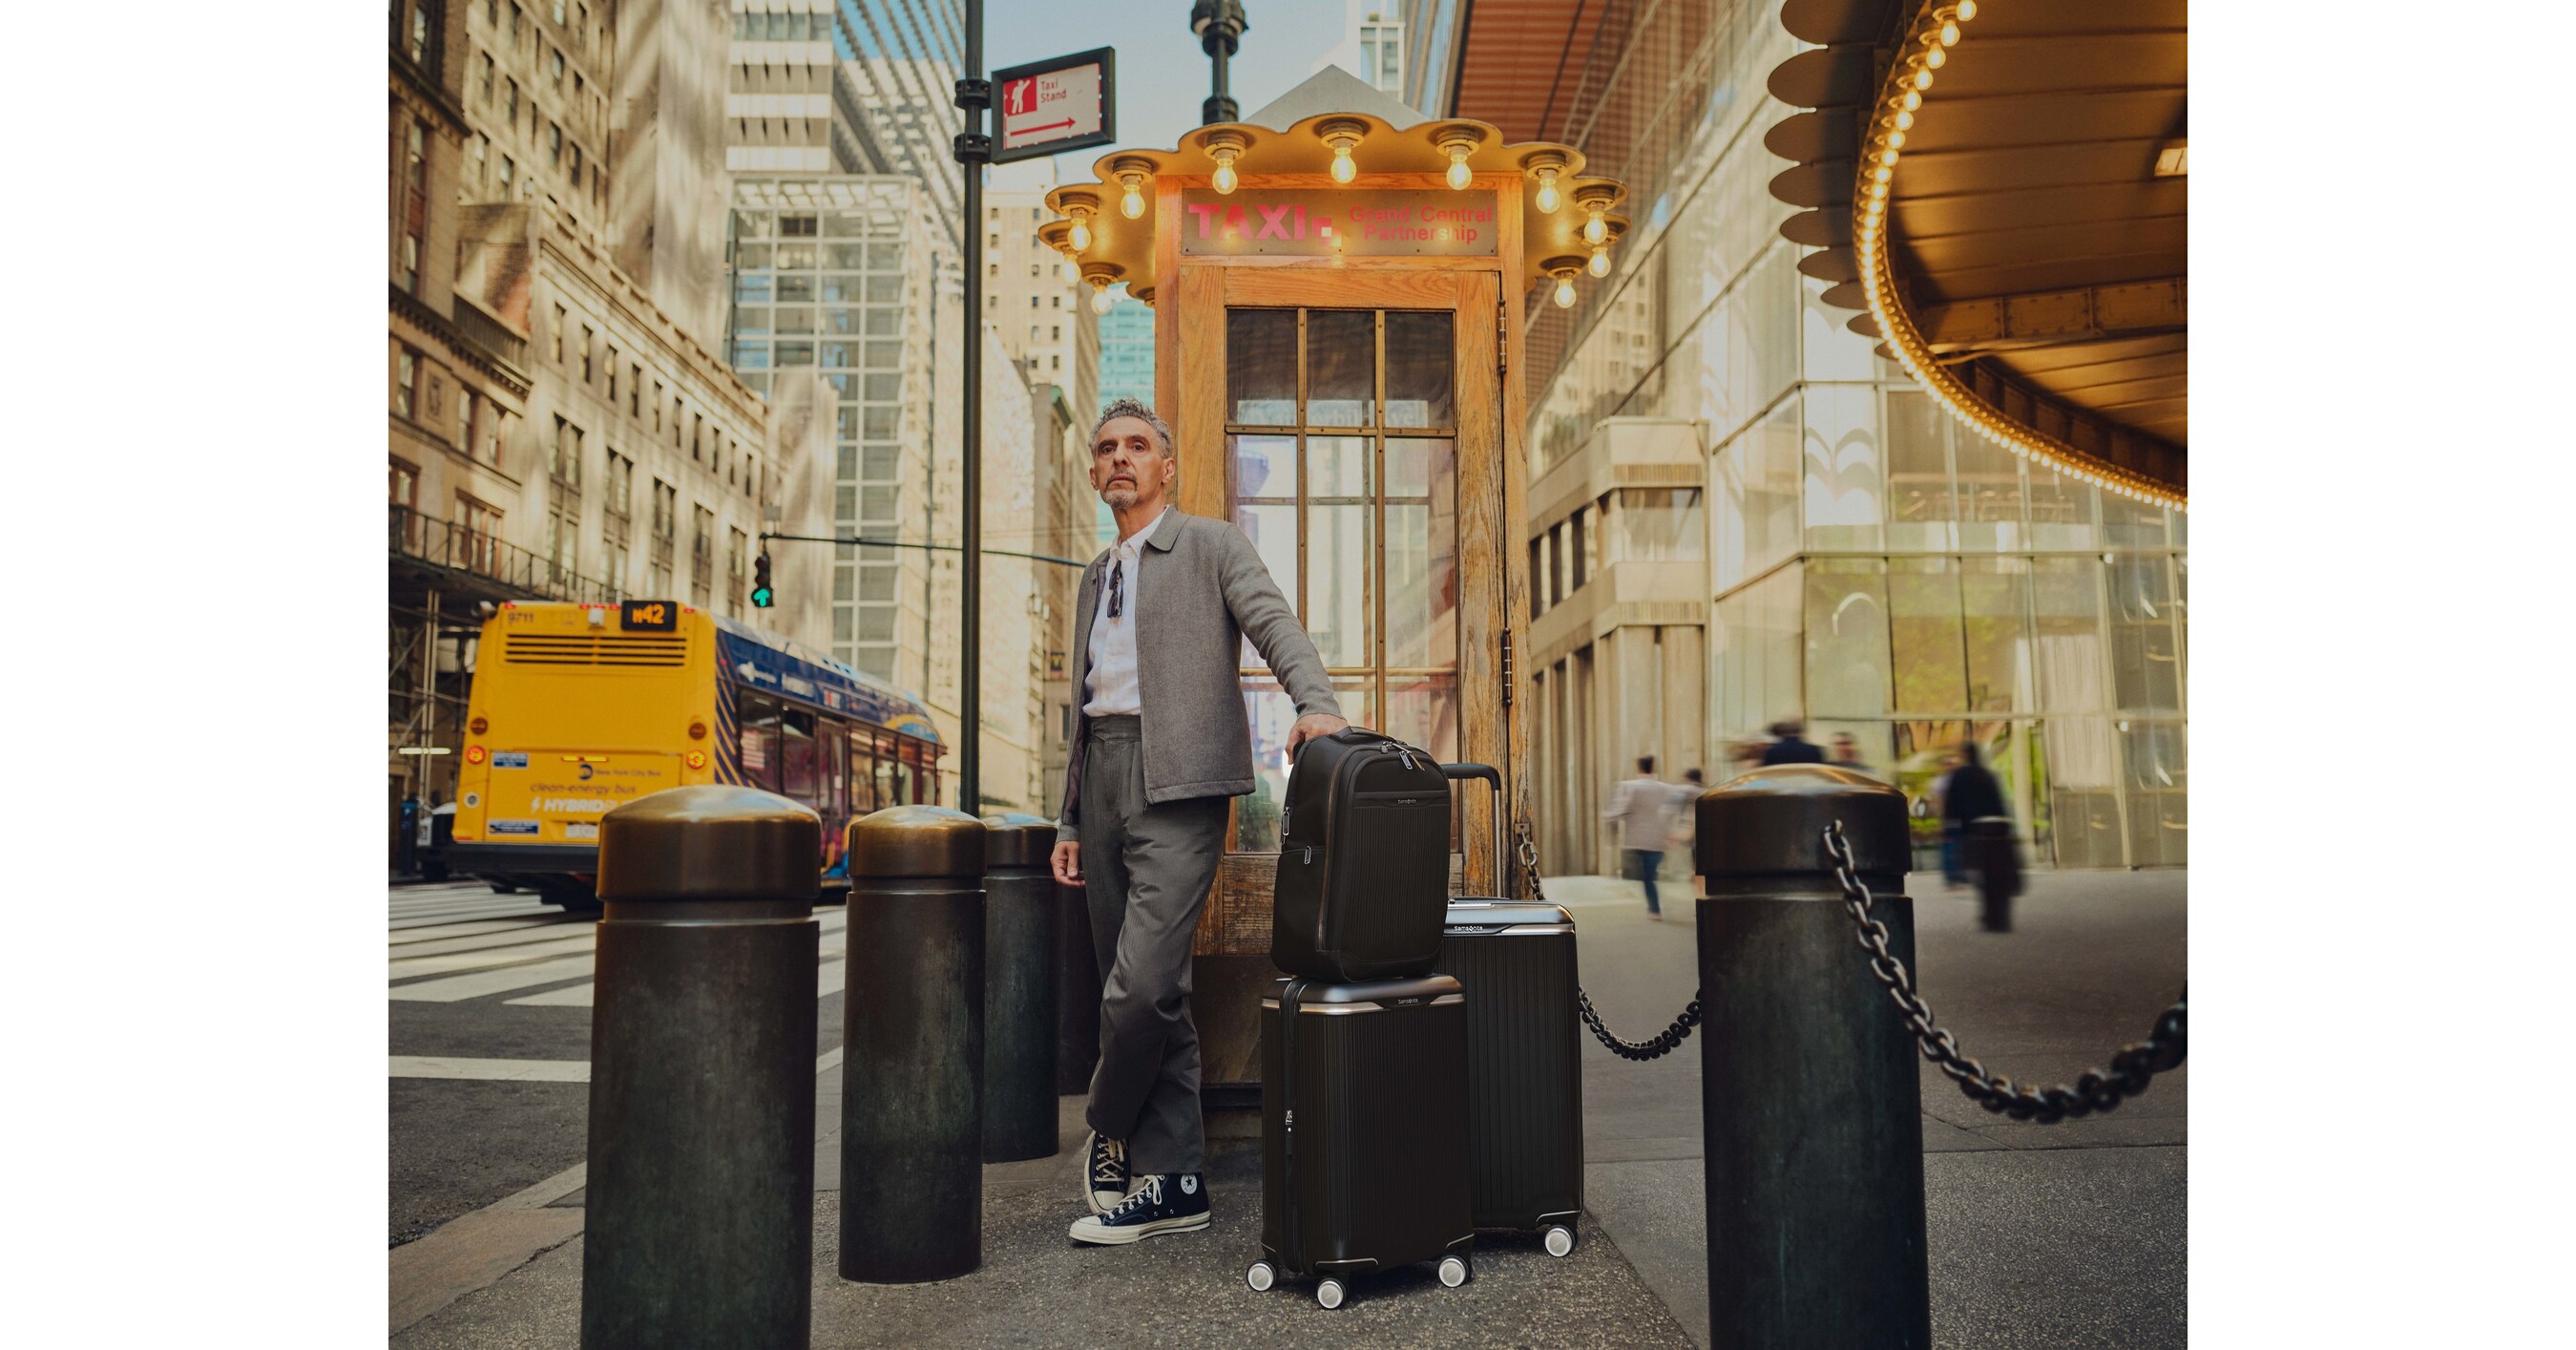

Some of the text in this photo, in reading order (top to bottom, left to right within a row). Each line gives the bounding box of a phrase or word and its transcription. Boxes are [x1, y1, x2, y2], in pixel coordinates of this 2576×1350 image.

[1040, 78, 1058, 91] Taxi
[1040, 89, 1067, 103] Stand
[1349, 205, 1493, 223] Grand Central
[1188, 203, 1308, 241] TAXI
[1364, 224, 1478, 244] Partnership
[508, 612, 534, 623] 9711
[531, 783, 637, 796] clean-energy bus
